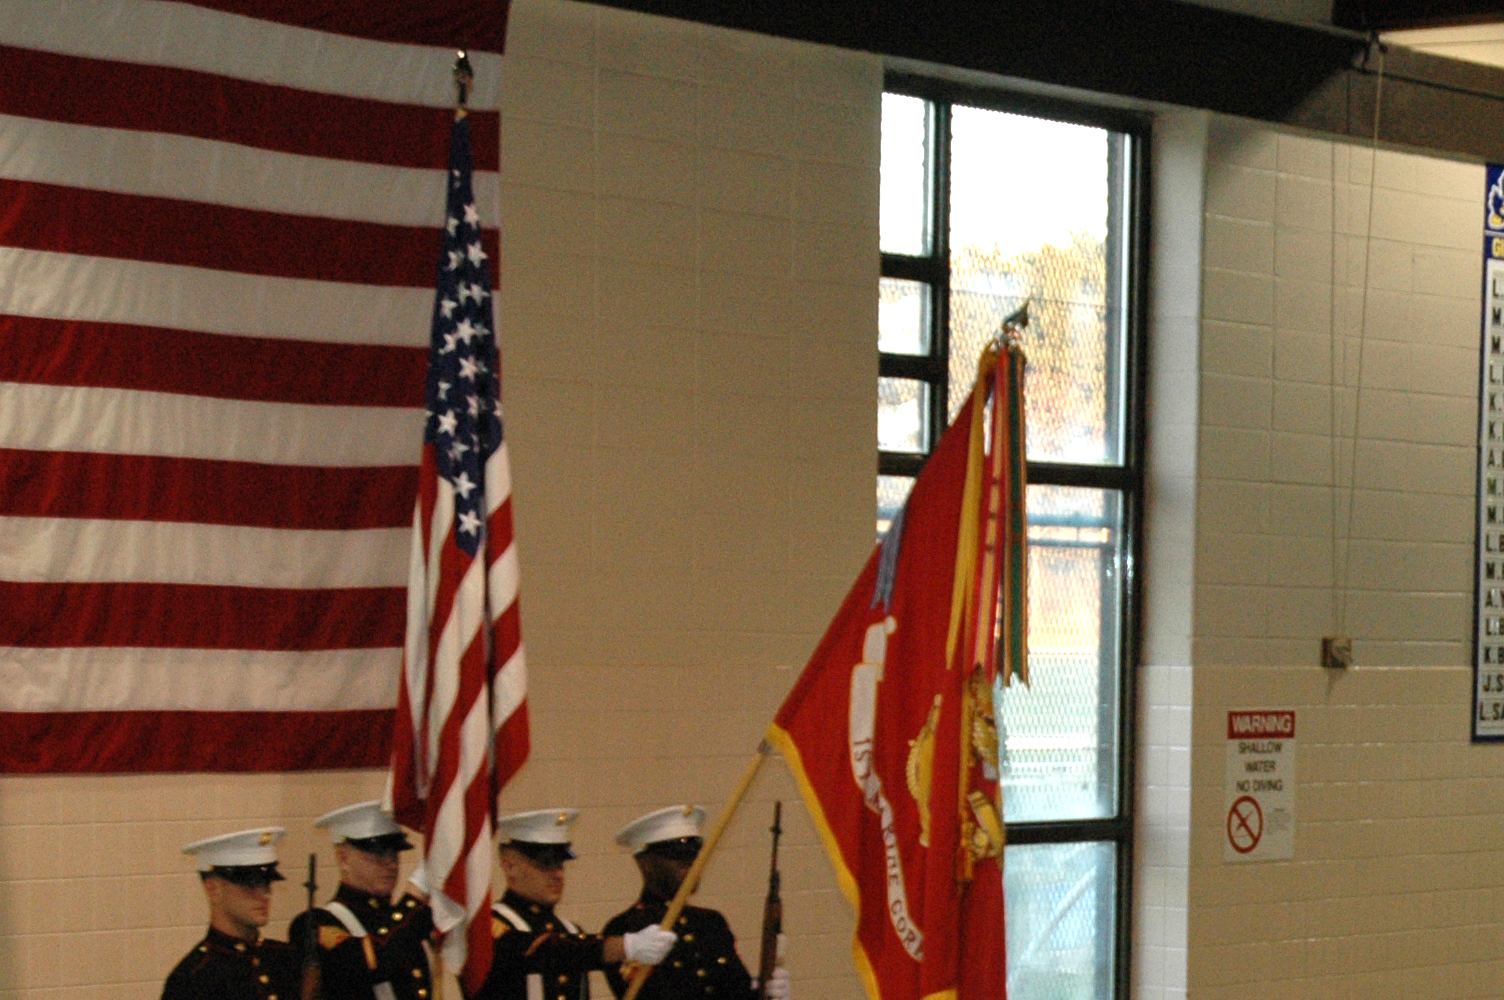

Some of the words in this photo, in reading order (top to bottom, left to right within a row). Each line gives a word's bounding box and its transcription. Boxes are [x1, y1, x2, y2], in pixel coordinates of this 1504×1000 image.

[1232, 714, 1292, 733] WARNING
[1238, 741, 1282, 754] SHALLOW
[1245, 760, 1276, 772] WATER
[1236, 780, 1250, 792] NO
[1253, 779, 1283, 792] DIVING
